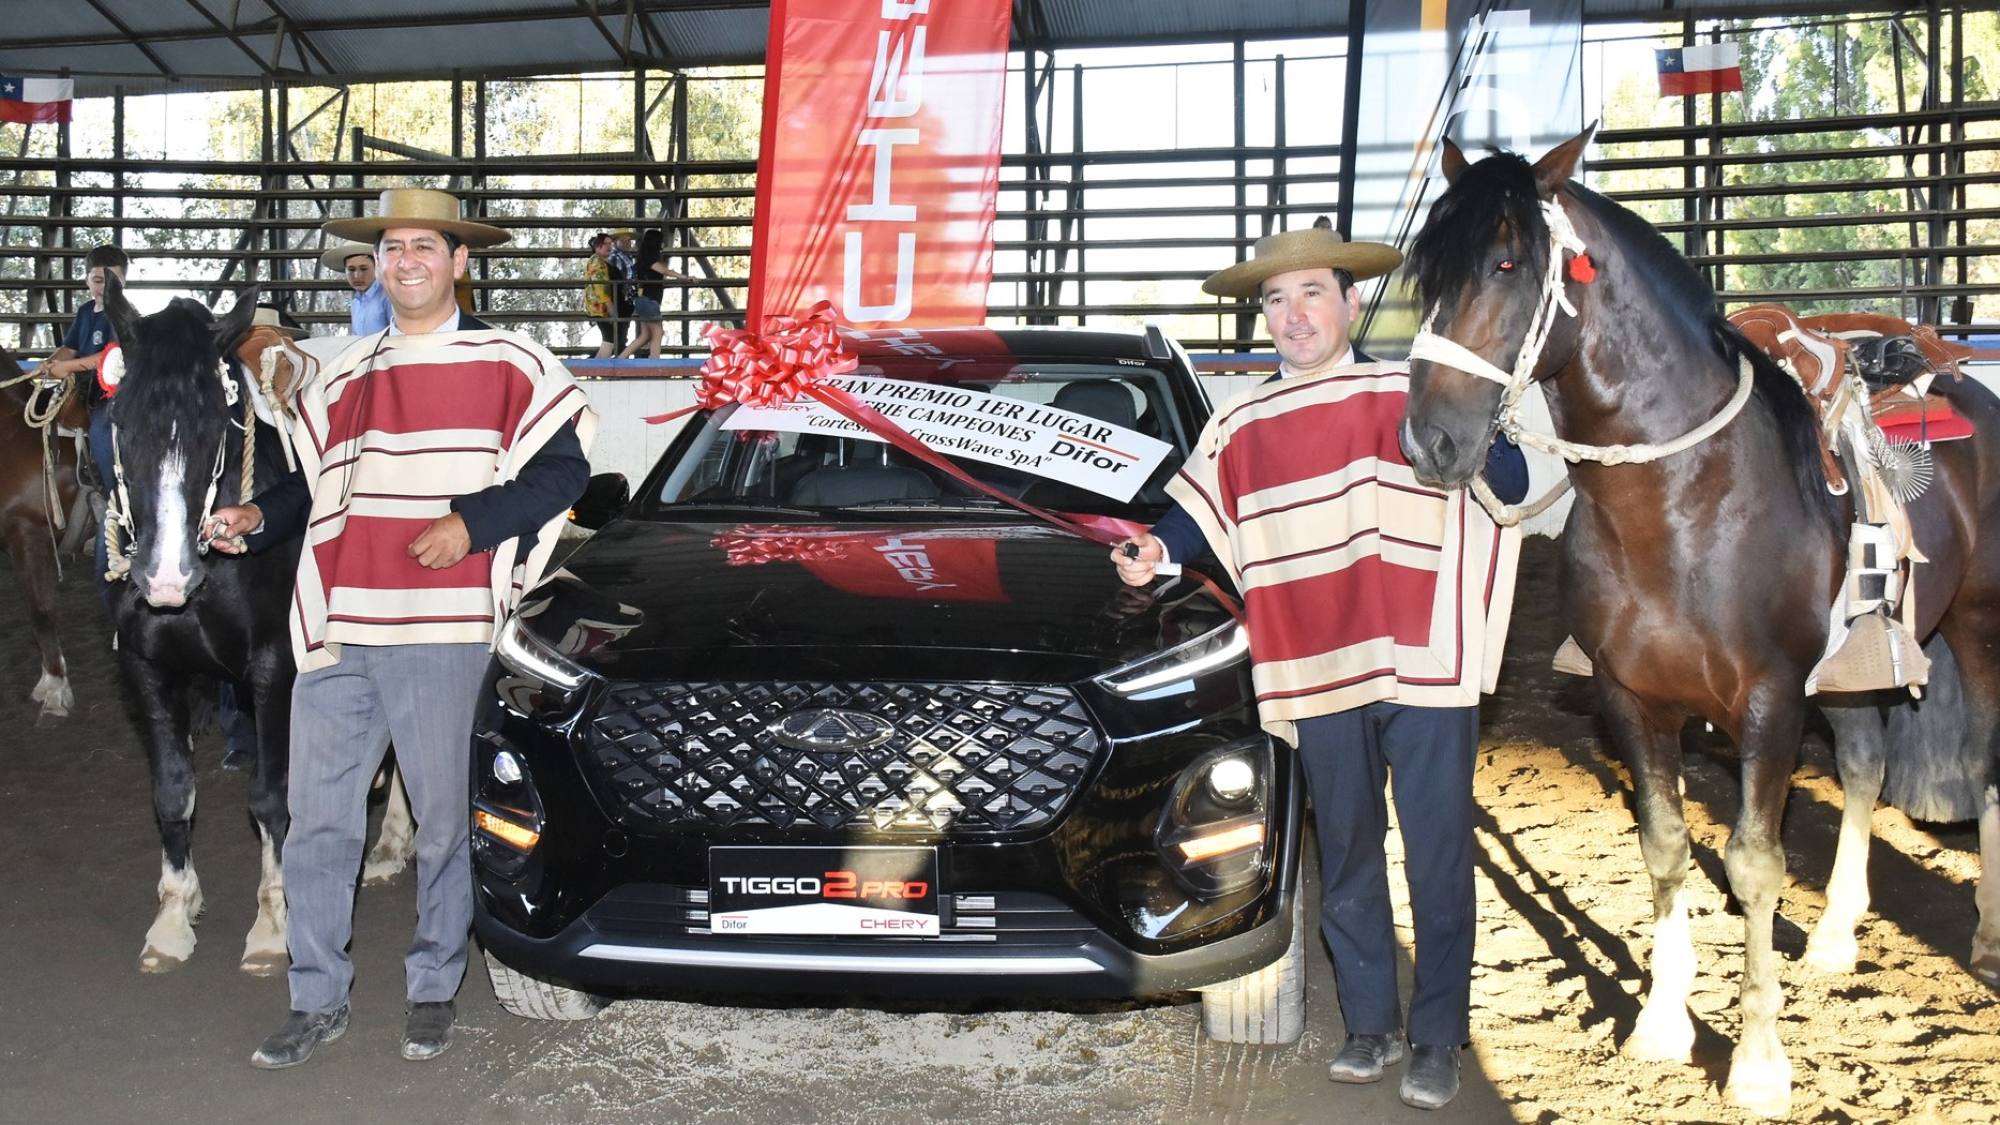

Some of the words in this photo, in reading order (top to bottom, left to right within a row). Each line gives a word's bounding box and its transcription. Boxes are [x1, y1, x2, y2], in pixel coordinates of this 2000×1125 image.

[842, 0, 930, 322] CHE
[874, 383, 972, 408] PREMIO
[976, 399, 1024, 419] 1ER
[1026, 409, 1113, 443] LUGAR
[908, 407, 1036, 443] CAMPEONES
[1050, 440, 1128, 474] Difor
[719, 876, 821, 895] TIGGO
[822, 871, 857, 898] 2
[860, 881, 928, 898] PRO
[721, 918, 747, 929] Difor
[860, 919, 928, 929] CHERY
